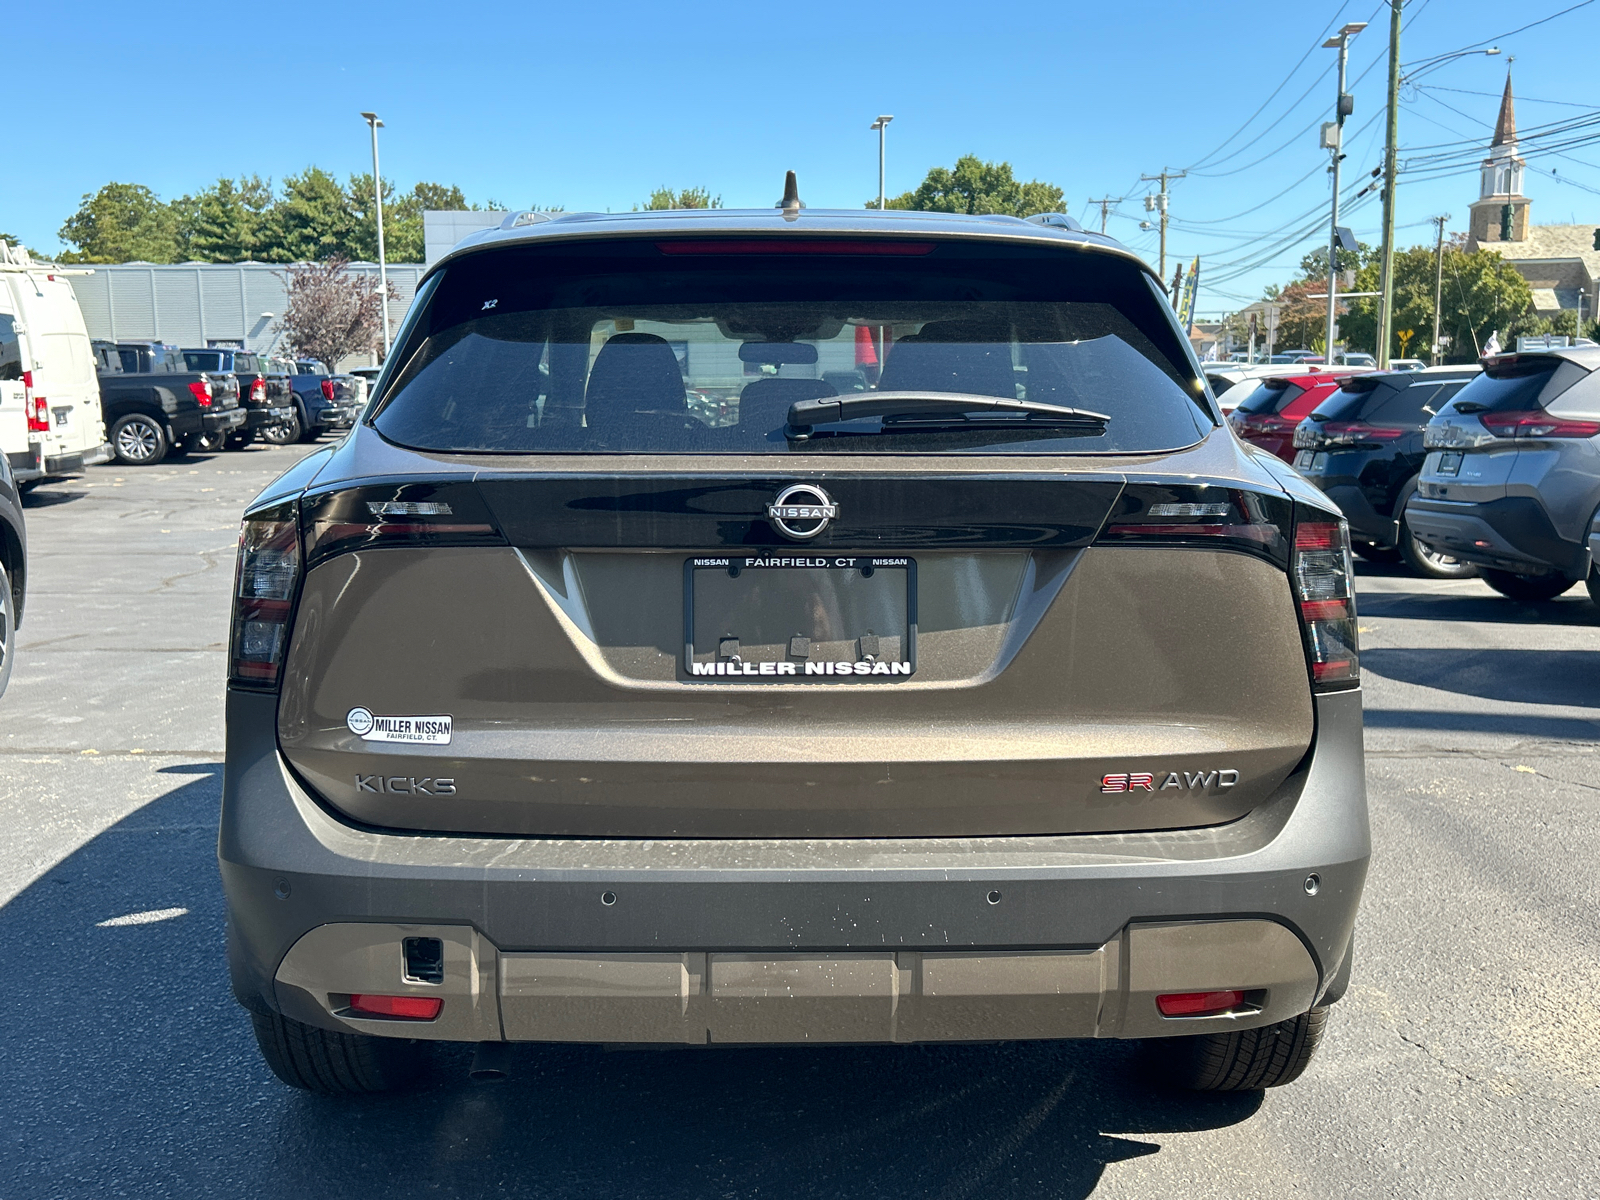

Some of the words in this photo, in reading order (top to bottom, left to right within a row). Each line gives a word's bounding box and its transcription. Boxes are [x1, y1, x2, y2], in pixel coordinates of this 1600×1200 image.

[770, 508, 833, 517] NISSAN
[694, 558, 729, 566] NISSAN
[745, 558, 830, 567] FAIRFIELD,
[834, 558, 857, 567] CT
[872, 558, 908, 566] NISSAN
[692, 662, 796, 675] MILLER
[804, 662, 911, 675] NISSAN
[375, 719, 411, 733] MILLER
[415, 721, 450, 735] NISSAN
[386, 733, 424, 741] FAIRFIELD,
[354, 773, 457, 796] KICKS
[1101, 772, 1154, 794] SR
[1158, 769, 1240, 791] AWD
